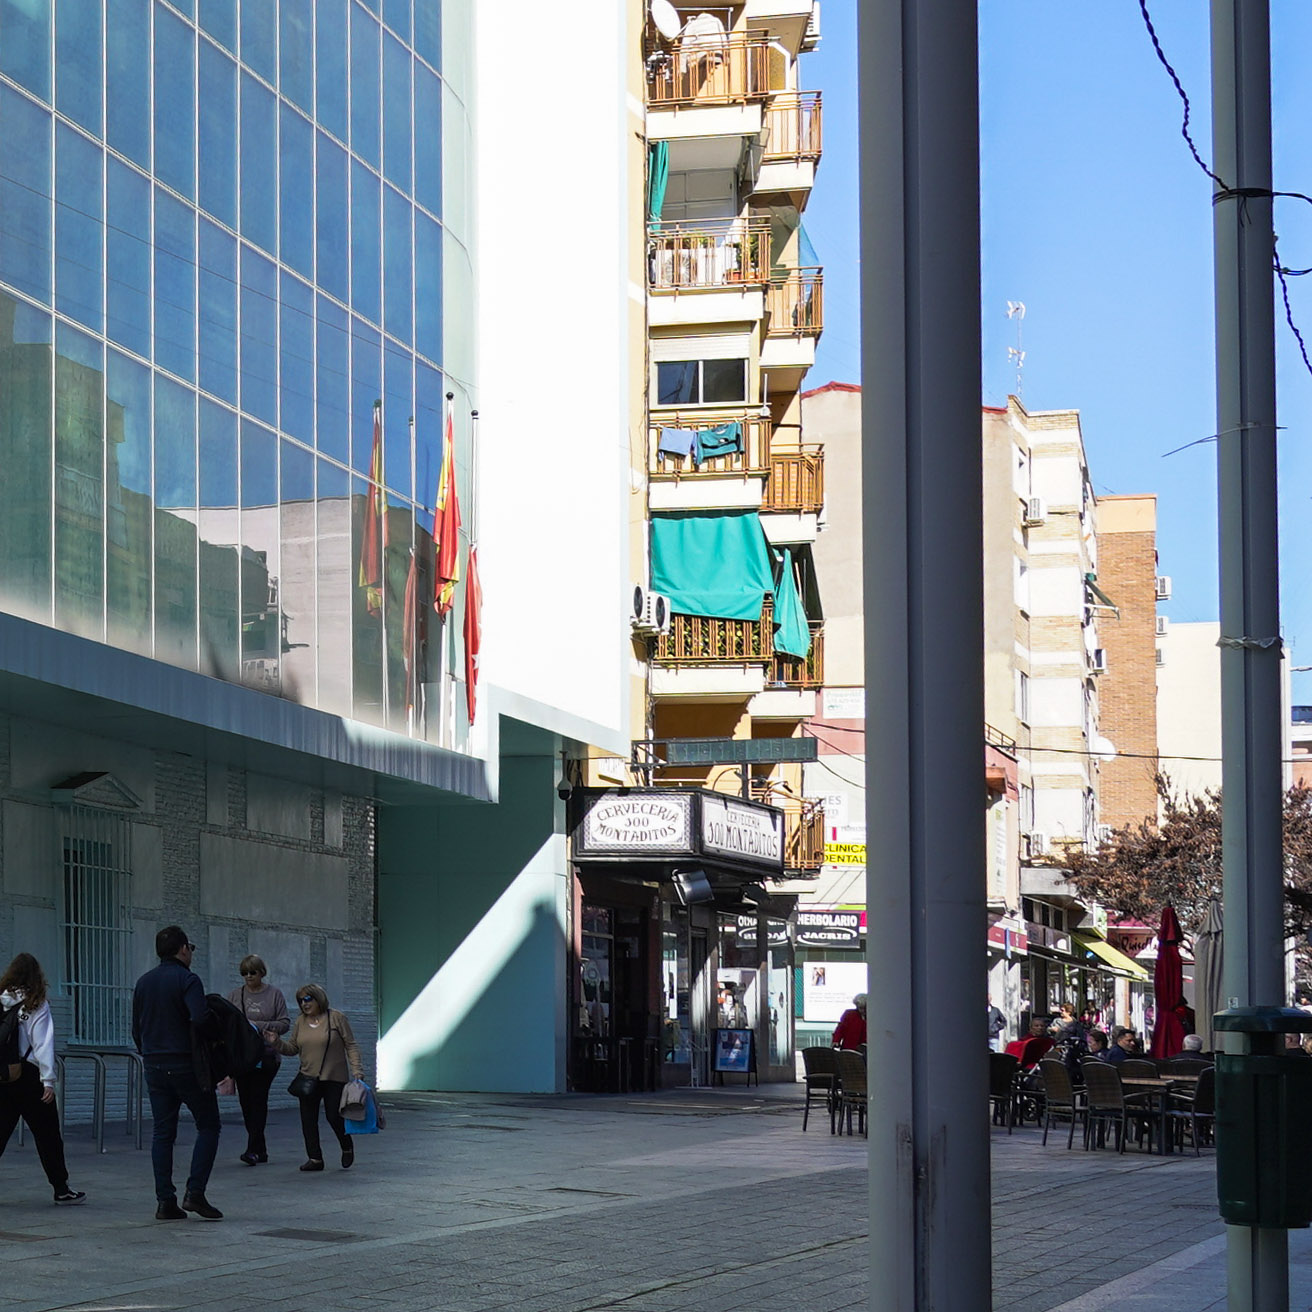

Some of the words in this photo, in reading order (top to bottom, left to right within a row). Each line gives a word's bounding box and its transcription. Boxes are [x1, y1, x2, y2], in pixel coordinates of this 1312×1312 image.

[596, 823, 677, 842] MONTADITOS
[726, 824, 778, 857] MONTADITOS
[797, 913, 858, 927] HERBOLARIO
